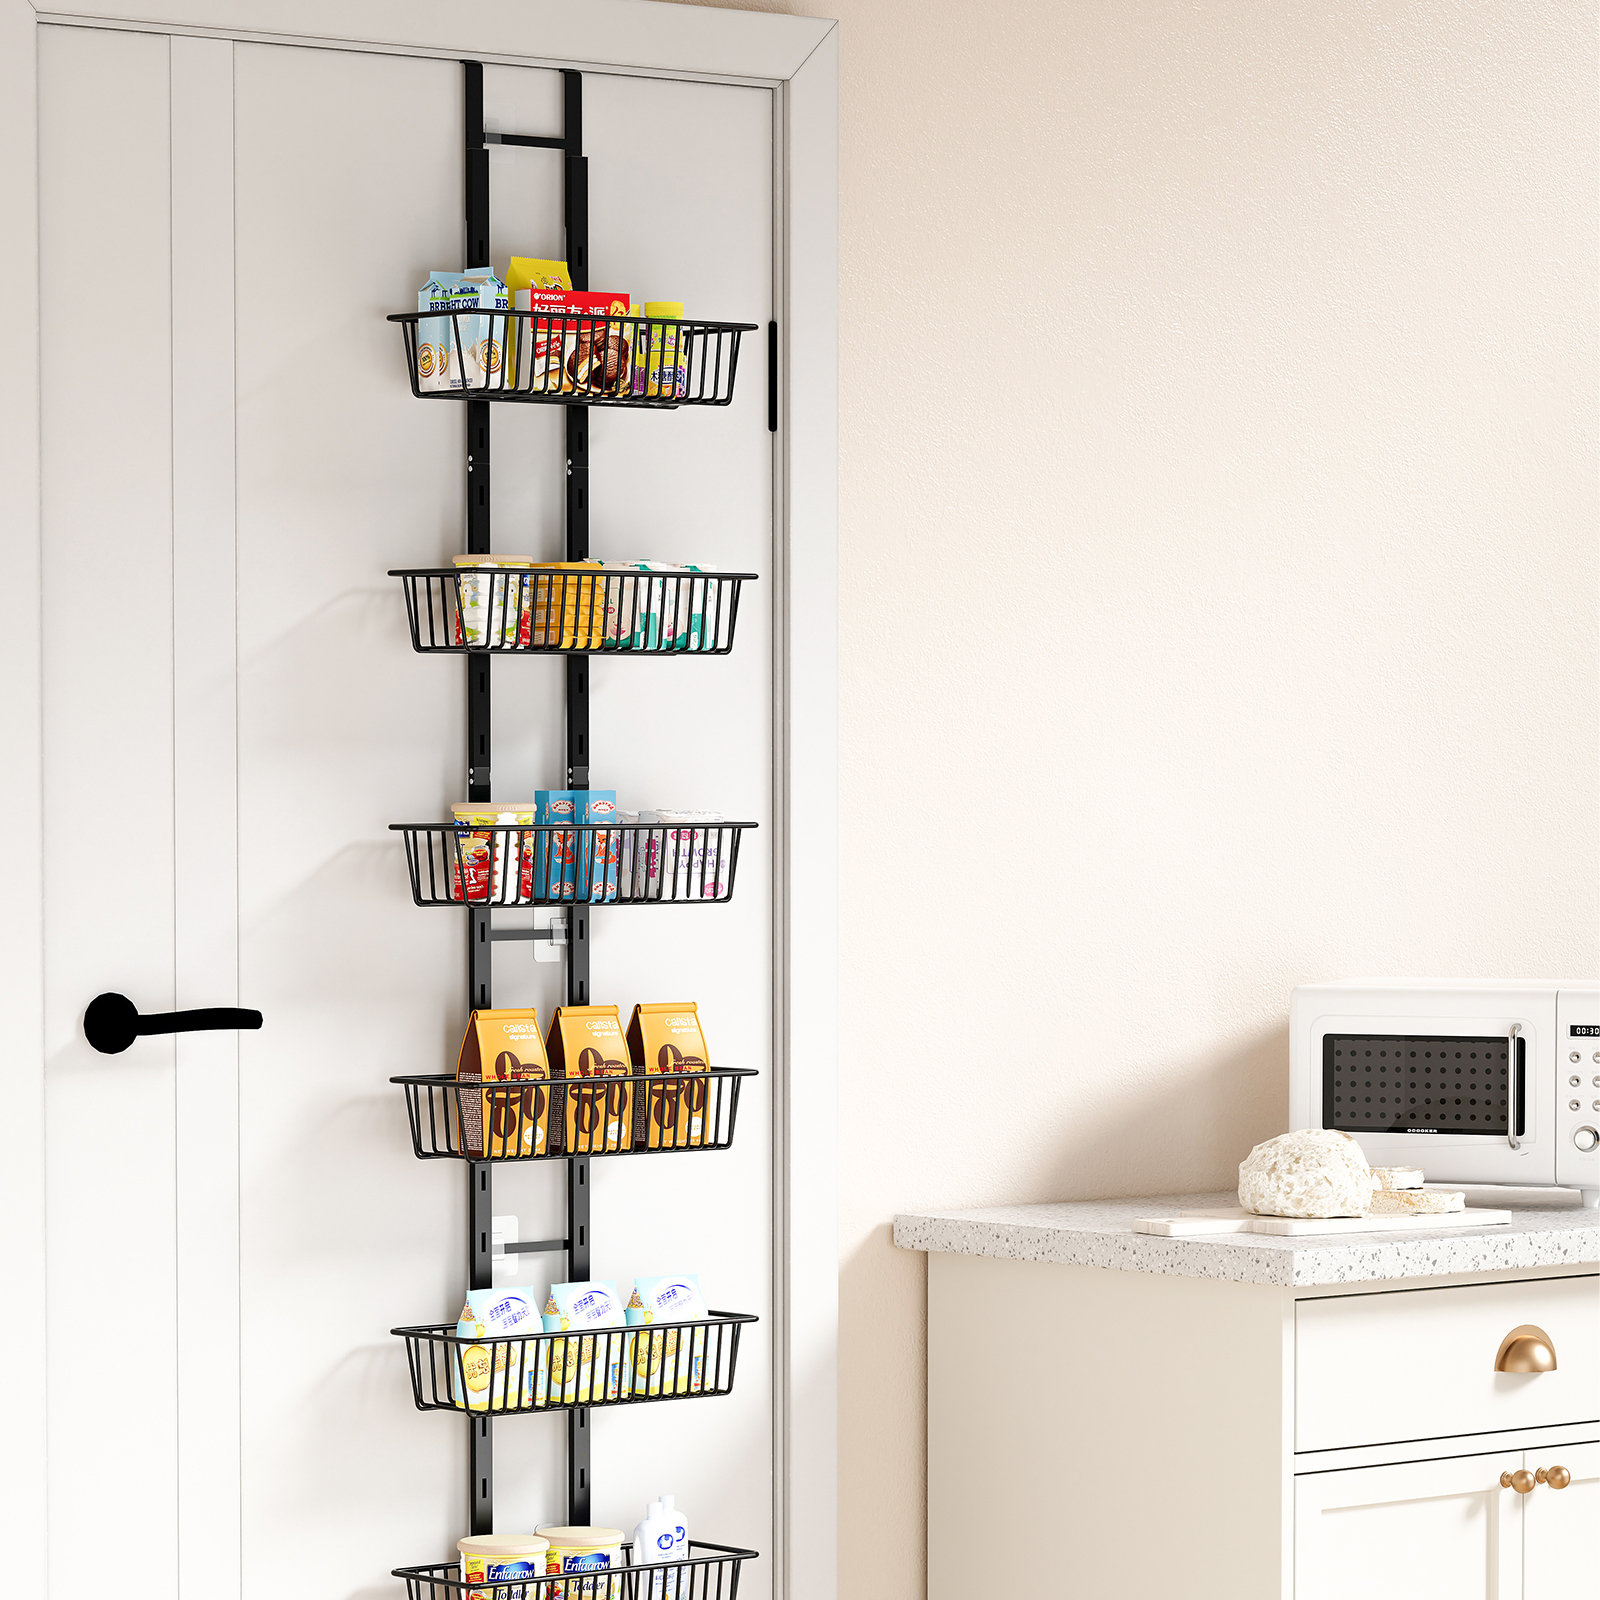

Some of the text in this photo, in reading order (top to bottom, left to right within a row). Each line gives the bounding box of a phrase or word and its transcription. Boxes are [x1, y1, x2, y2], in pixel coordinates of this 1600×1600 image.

[540, 293, 564, 302] ORION
[461, 297, 479, 309] COW
[592, 1030, 619, 1038] signature
[1576, 1027, 1600, 1035] 00:30
